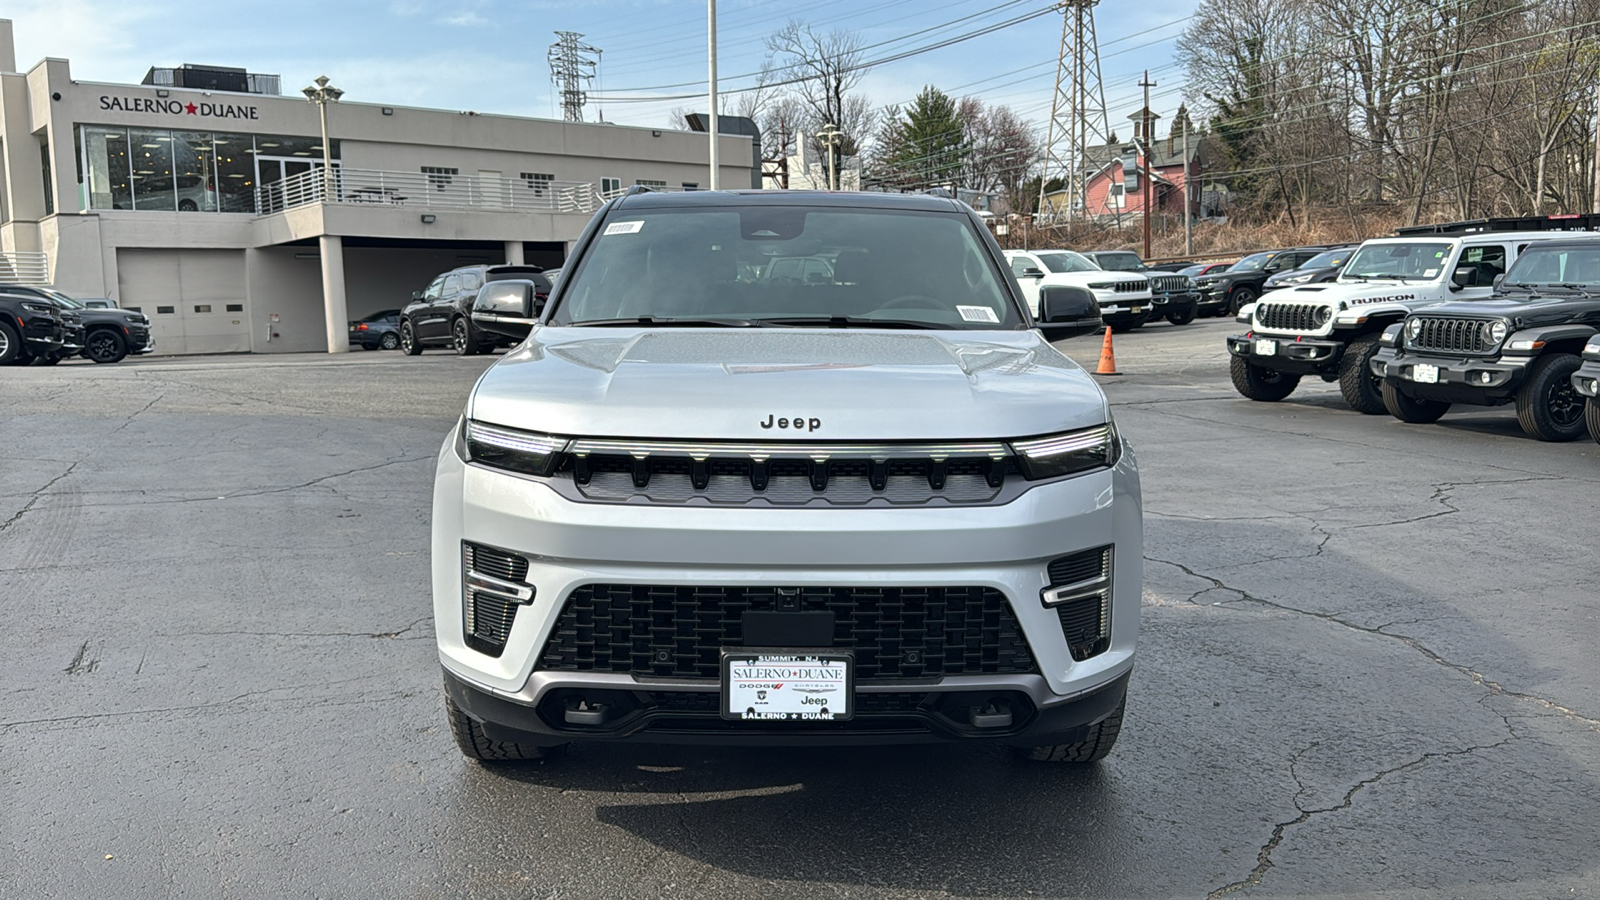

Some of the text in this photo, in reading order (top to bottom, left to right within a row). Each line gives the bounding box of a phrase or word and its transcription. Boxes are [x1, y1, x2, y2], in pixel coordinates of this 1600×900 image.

[99, 95, 259, 121] SALERNO DUANE
[1351, 294, 1415, 305] RUBICON
[760, 414, 821, 432] Jeep
[734, 669, 843, 680] SALERNO DUANE
[801, 696, 828, 706] Jeep
